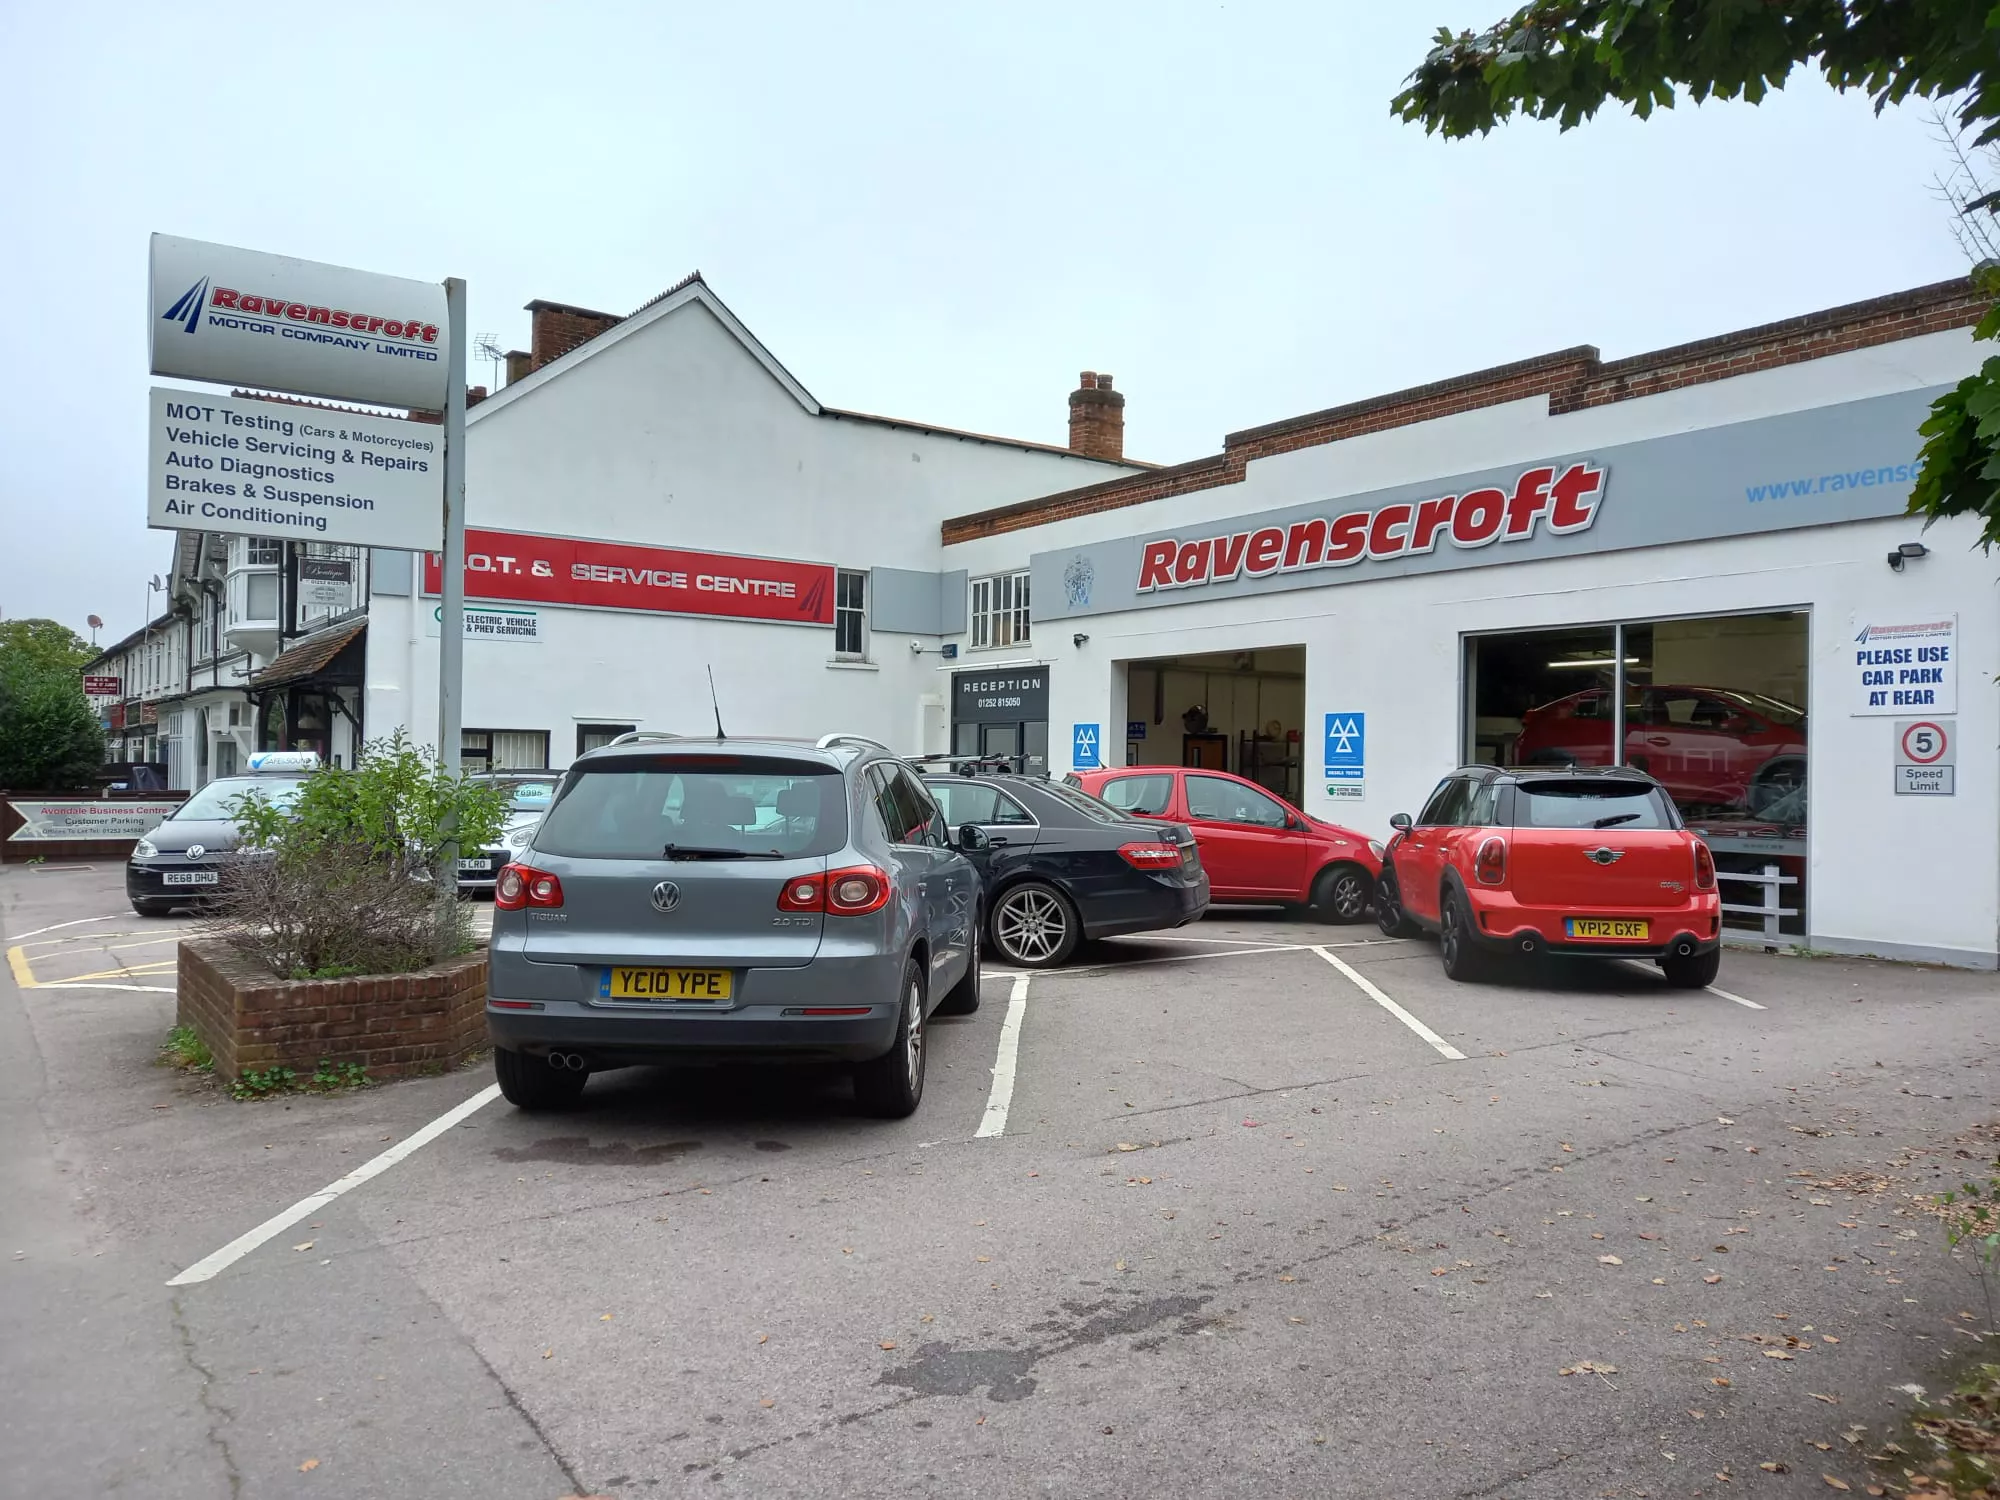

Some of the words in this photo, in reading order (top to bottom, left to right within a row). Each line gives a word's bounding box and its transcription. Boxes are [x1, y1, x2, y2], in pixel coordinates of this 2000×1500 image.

[210, 287, 439, 344] Ravenscroft
[209, 316, 275, 335] MOTOR
[282, 328, 370, 350] COMPANY
[377, 344, 437, 361] LIMITED
[167, 403, 214, 422] MOT
[221, 410, 293, 436] Testing
[300, 424, 334, 438] (Cars
[340, 430, 348, 440] &
[353, 431, 434, 452] Motorcycles)
[167, 427, 239, 448] Vehicle
[246, 437, 335, 464] Servicing
[342, 449, 354, 463] &
[361, 451, 428, 472] Repairs
[166, 452, 214, 469] Auto
[221, 458, 334, 483] Diagnostics
[1746, 461, 1923, 502] www.ravensc
[166, 475, 236, 496] Brakes
[243, 484, 256, 497] &
[264, 486, 374, 510] Suspension
[165, 499, 194, 515] Air
[201, 503, 326, 531] Conditioning
[1135, 461, 1608, 593] Ravenscroft
[532, 560, 553, 577] &
[572, 564, 687, 589] SERVICE
[696, 575, 795, 598] CENTRE
[467, 615, 502, 625] ELECTRIC
[506, 618, 536, 627] VEHICLE
[467, 624, 472, 632] &
[475, 625, 494, 633] PHEV
[496, 626, 536, 636] SERVICING
[1857, 649, 1912, 665] PLEASE
[1918, 647, 1949, 662] USE
[964, 679, 1041, 693] RECEPTION
[1862, 671, 1893, 685] CAR
[1900, 668, 1943, 684] PARK
[979, 699, 996, 707] 01252
[998, 697, 1020, 706] 815050
[1869, 691, 1888, 706] AT
[1893, 690, 1934, 705] REAR
[1916, 733, 1932, 753] 5
[1906, 769, 1943, 779] Speed
[1910, 781, 1940, 790] Limit
[111, 817, 144, 825] Parking
[168, 874, 192, 882] RE68
[1578, 921, 1611, 935] YP12
[1615, 923, 1642, 936] GXF
[621, 971, 669, 993] YC10
[677, 972, 721, 994] YPE
